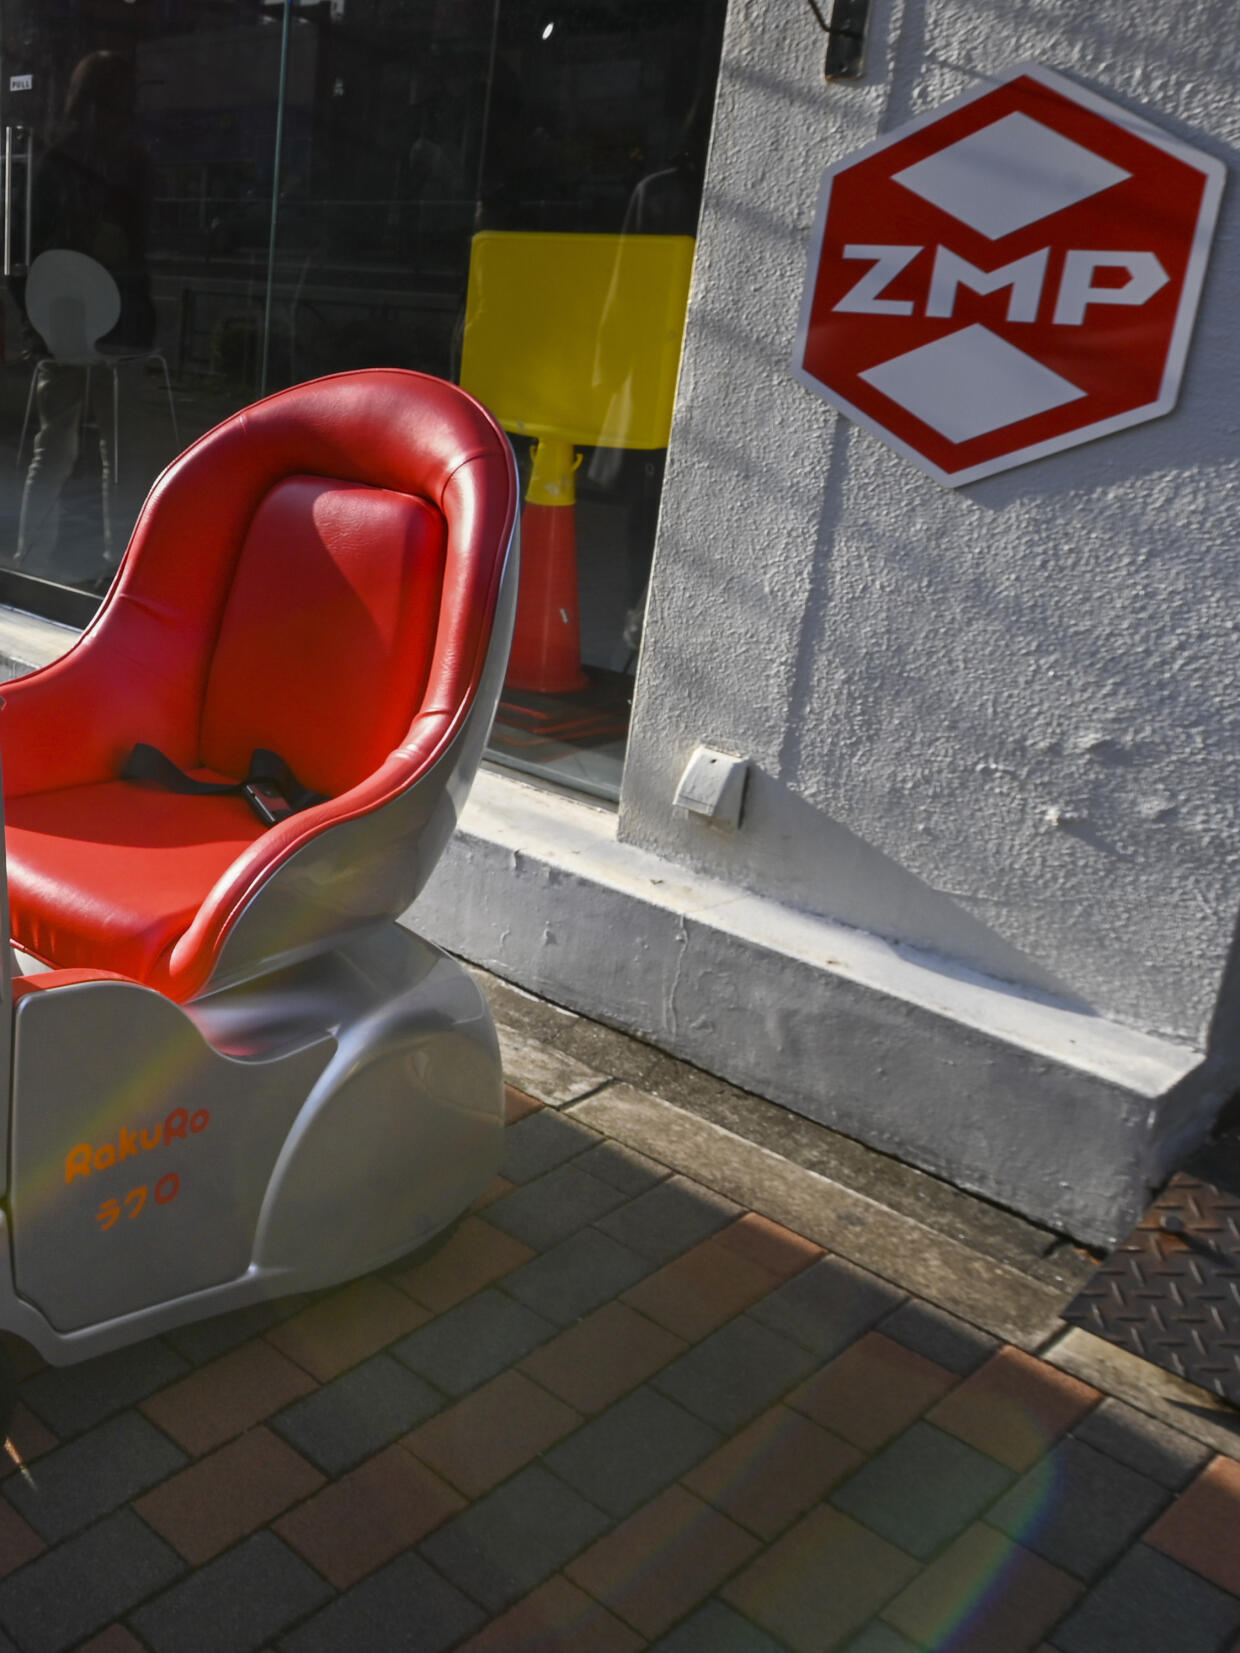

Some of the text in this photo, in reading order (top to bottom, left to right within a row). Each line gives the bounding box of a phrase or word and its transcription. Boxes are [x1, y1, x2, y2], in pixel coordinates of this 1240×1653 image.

[12, 80, 30, 89] PULL
[831, 243, 1171, 326] ZMP
[65, 1107, 211, 1184] RakuRo
[96, 1172, 181, 1232] ラクロ
